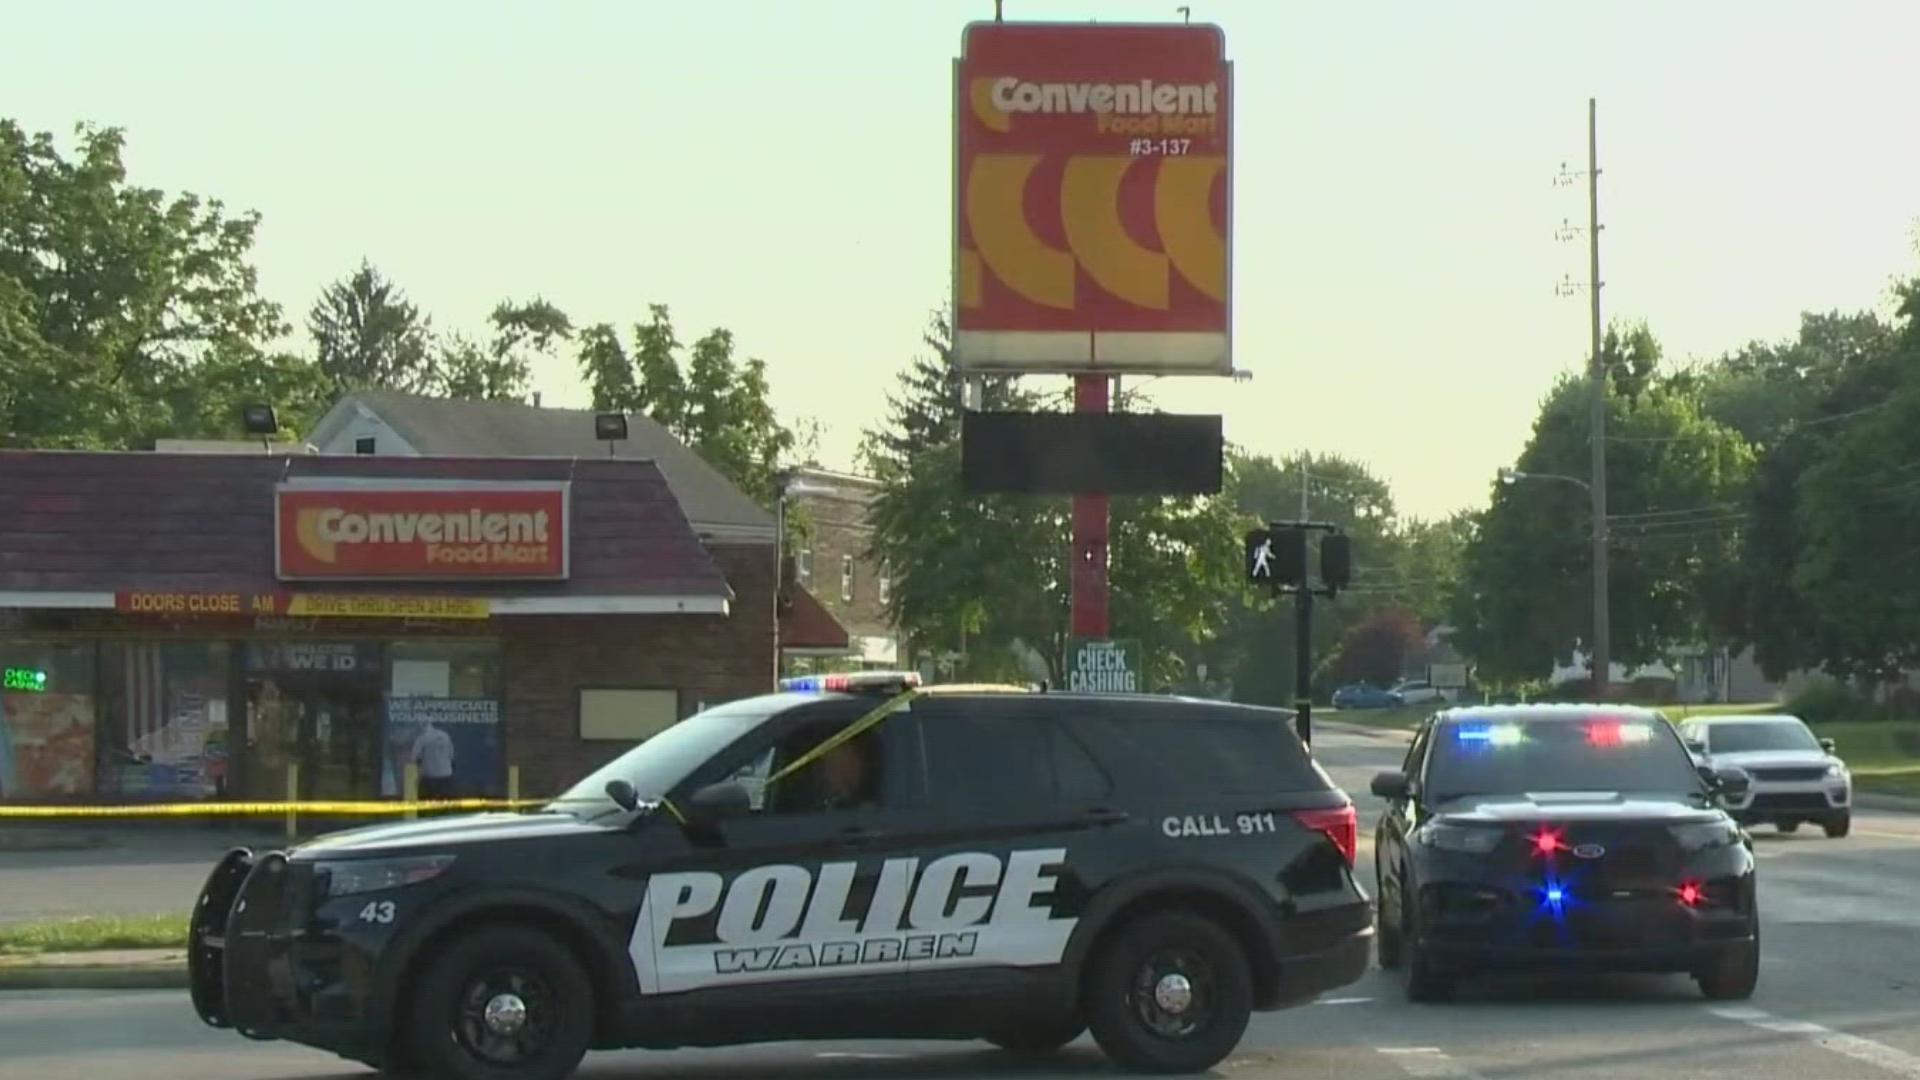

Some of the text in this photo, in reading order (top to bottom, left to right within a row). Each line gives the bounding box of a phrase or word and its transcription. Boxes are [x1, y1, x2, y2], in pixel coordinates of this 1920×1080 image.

[992, 77, 1217, 113] Convenient
[1098, 115, 1217, 133] Food Mart
[1130, 138, 1191, 155] #3-137
[318, 507, 548, 543] Convenient
[426, 545, 548, 564] Food Mart
[131, 594, 274, 612] DOORS CLOSE AM
[306, 596, 346, 613] DRIVE
[350, 596, 384, 613] THRU
[389, 597, 424, 614] OPEN
[290, 654, 327, 669] WE
[1077, 649, 1126, 671] CHECK
[1070, 670, 1136, 692] CASHING
[1162, 812, 1276, 837] CALL 911
[646, 848, 1067, 947] POLICE
[359, 901, 396, 923] 43
[713, 931, 979, 974] WARREN
